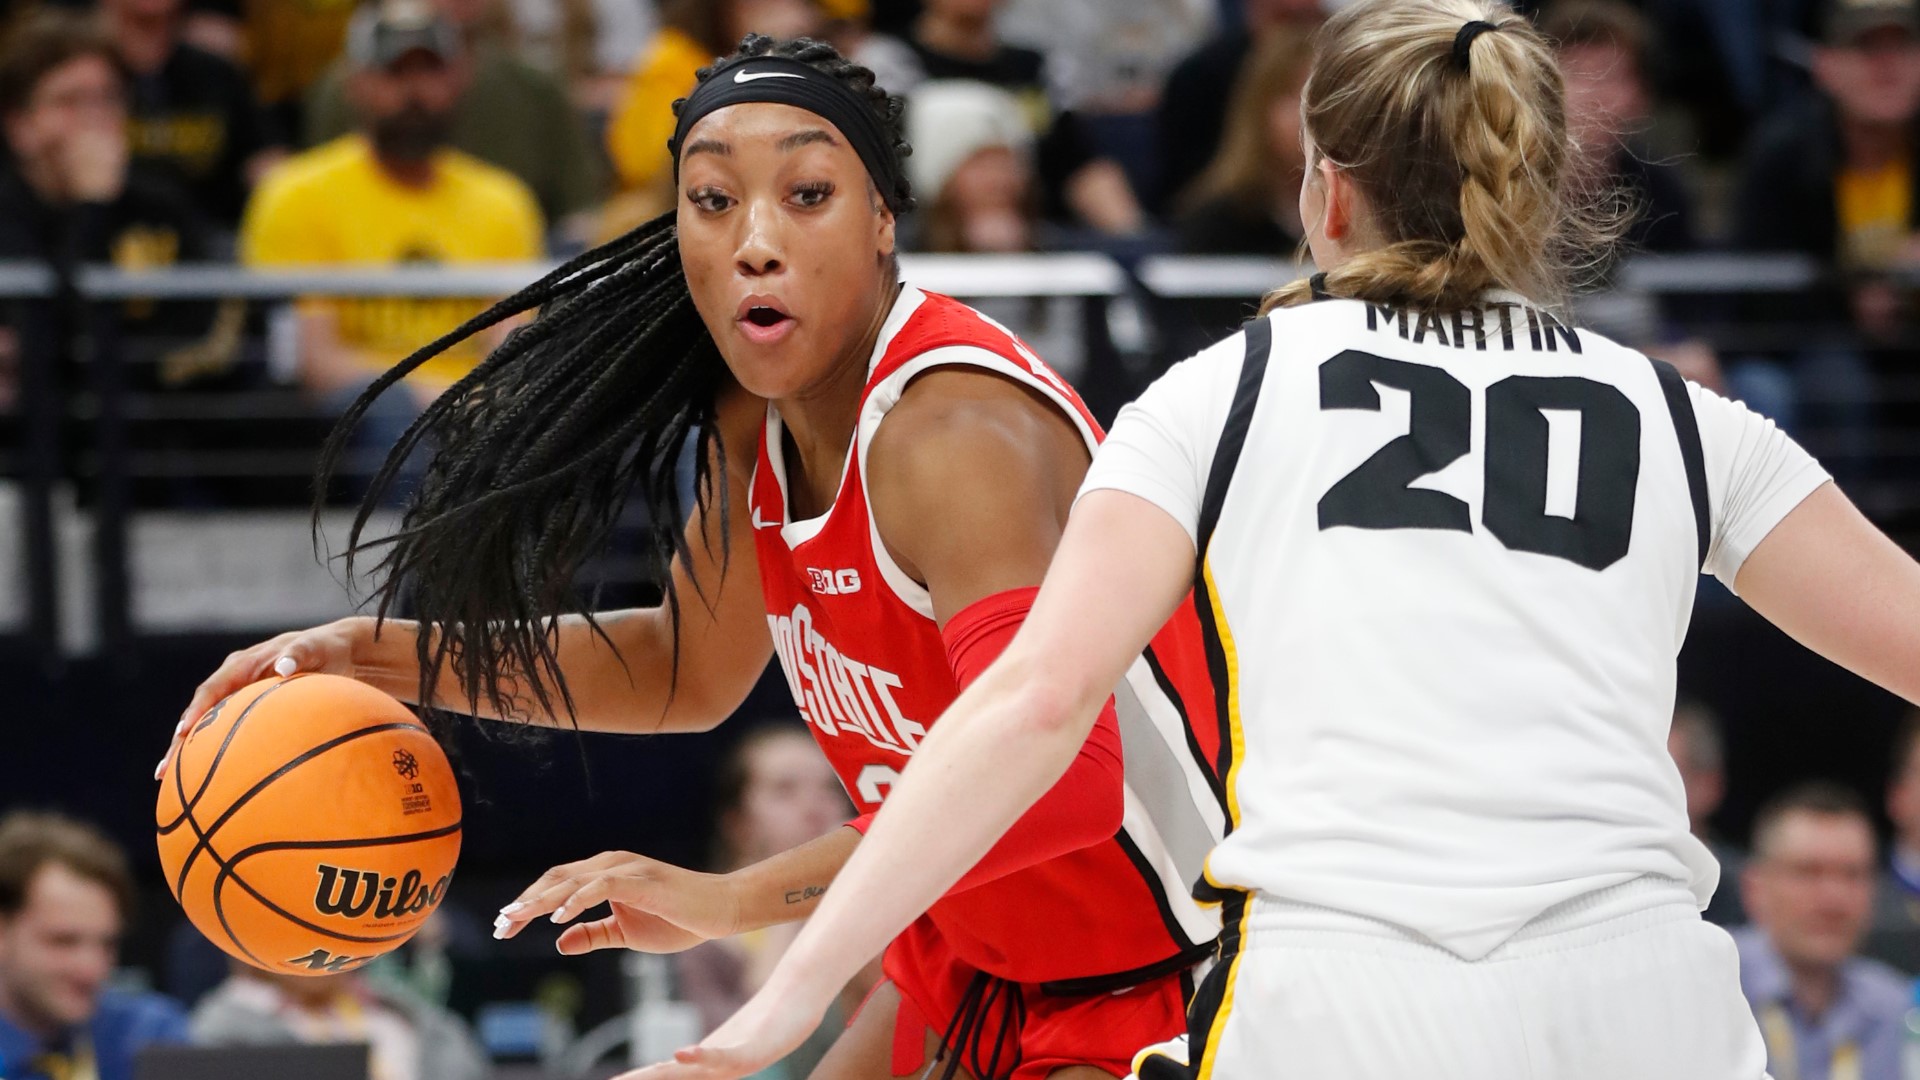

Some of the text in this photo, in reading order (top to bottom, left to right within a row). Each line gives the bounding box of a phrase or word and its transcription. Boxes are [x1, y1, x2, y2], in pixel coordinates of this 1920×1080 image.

[1365, 301, 1583, 355] MARTIN
[1317, 348, 1641, 572] 20
[314, 863, 456, 920] Wilso
